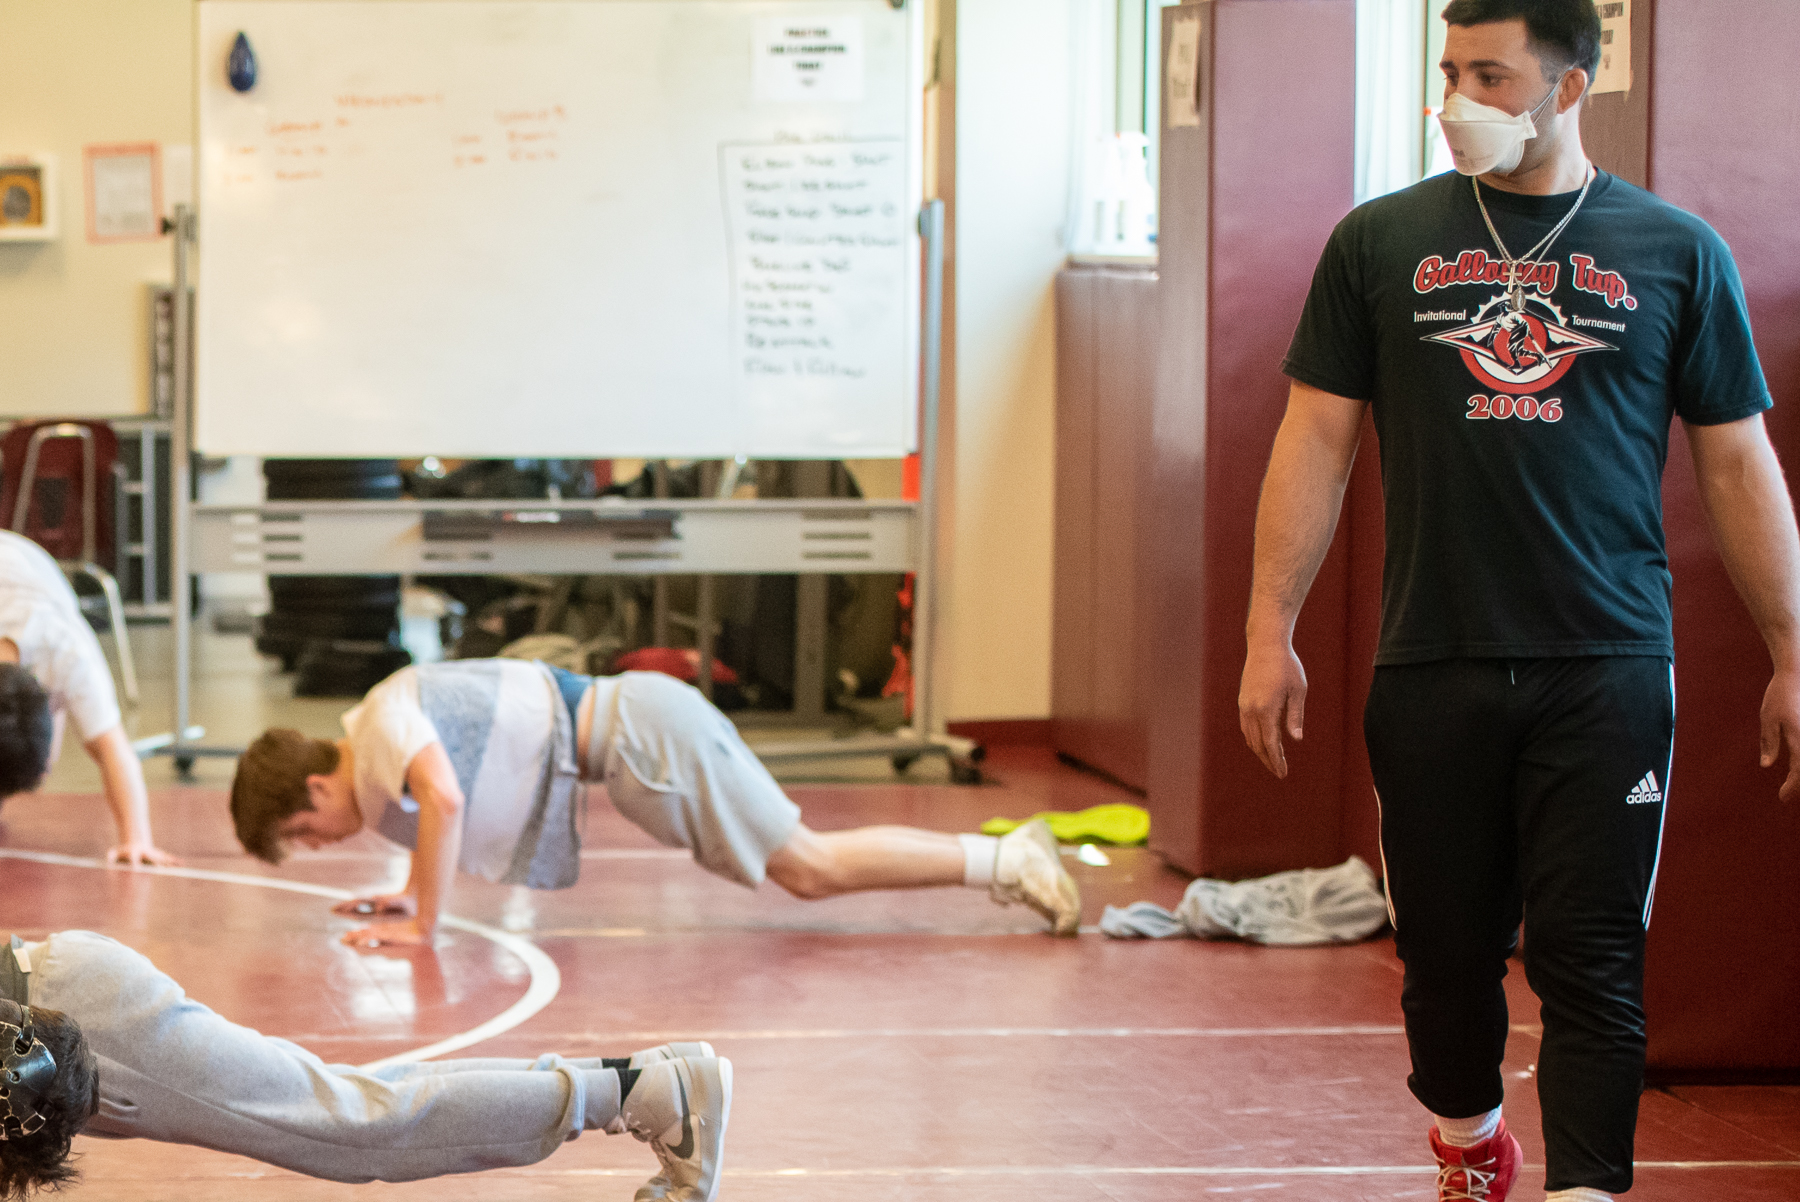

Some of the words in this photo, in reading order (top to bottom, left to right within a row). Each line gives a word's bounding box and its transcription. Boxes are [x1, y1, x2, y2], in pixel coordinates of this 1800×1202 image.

[1413, 250, 1559, 295] Galloway
[1569, 253, 1638, 311] Twp.
[1413, 309, 1467, 323] Invitational
[1571, 314, 1626, 333] Tournament
[1465, 394, 1563, 423] 2006
[1625, 790, 1662, 804] adidas
